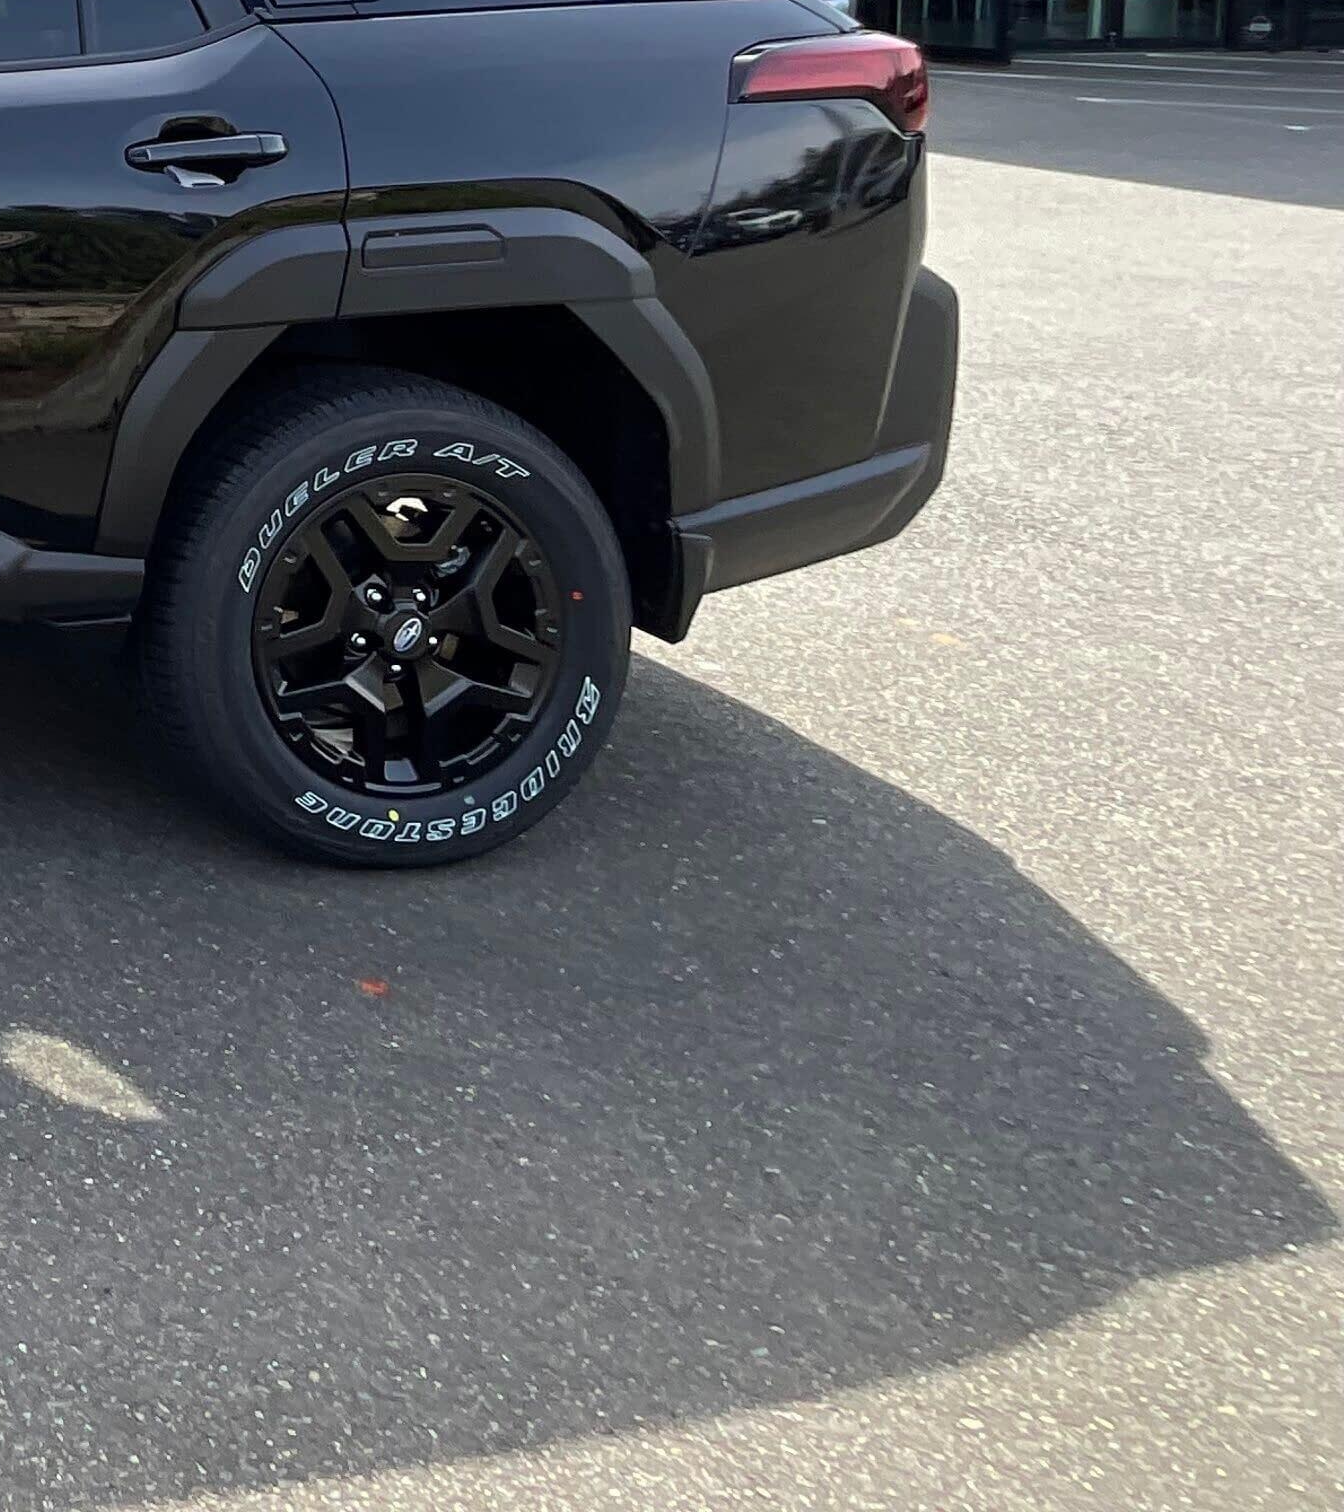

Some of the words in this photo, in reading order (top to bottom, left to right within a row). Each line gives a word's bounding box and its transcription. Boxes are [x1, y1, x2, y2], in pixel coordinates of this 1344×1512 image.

[237, 437, 418, 595] DUELER
[432, 441, 531, 481] A/T
[294, 676, 602, 843] BRIDGESTONE
